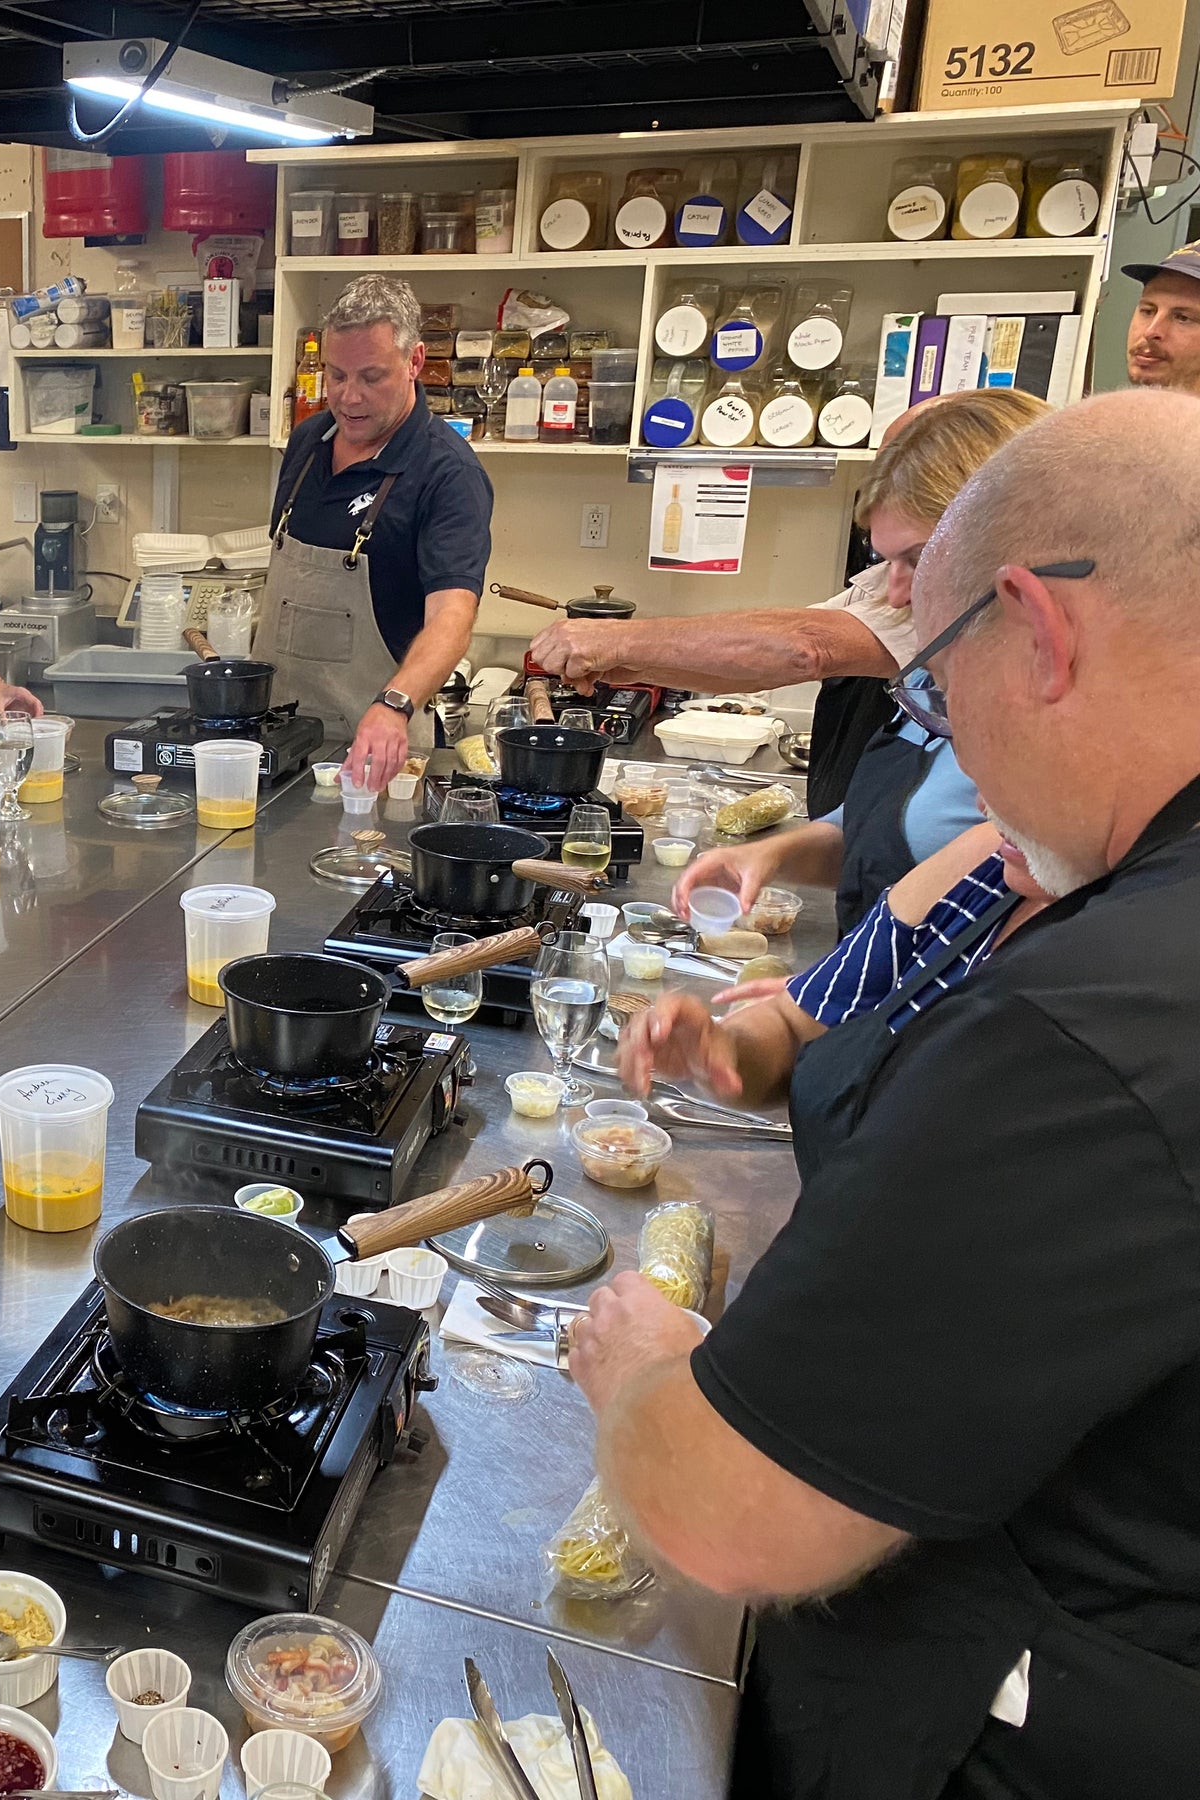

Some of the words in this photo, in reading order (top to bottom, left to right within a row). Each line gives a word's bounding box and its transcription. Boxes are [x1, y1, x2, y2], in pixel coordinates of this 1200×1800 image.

[944, 42, 1036, 80] 5132
[941, 86, 1003, 97] Quantity:100
[686, 213, 710, 221] CAJUN
[961, 351, 972, 372] TEAM
[716, 405, 740, 421] Powder
[727, 400, 746, 419] Garlic
